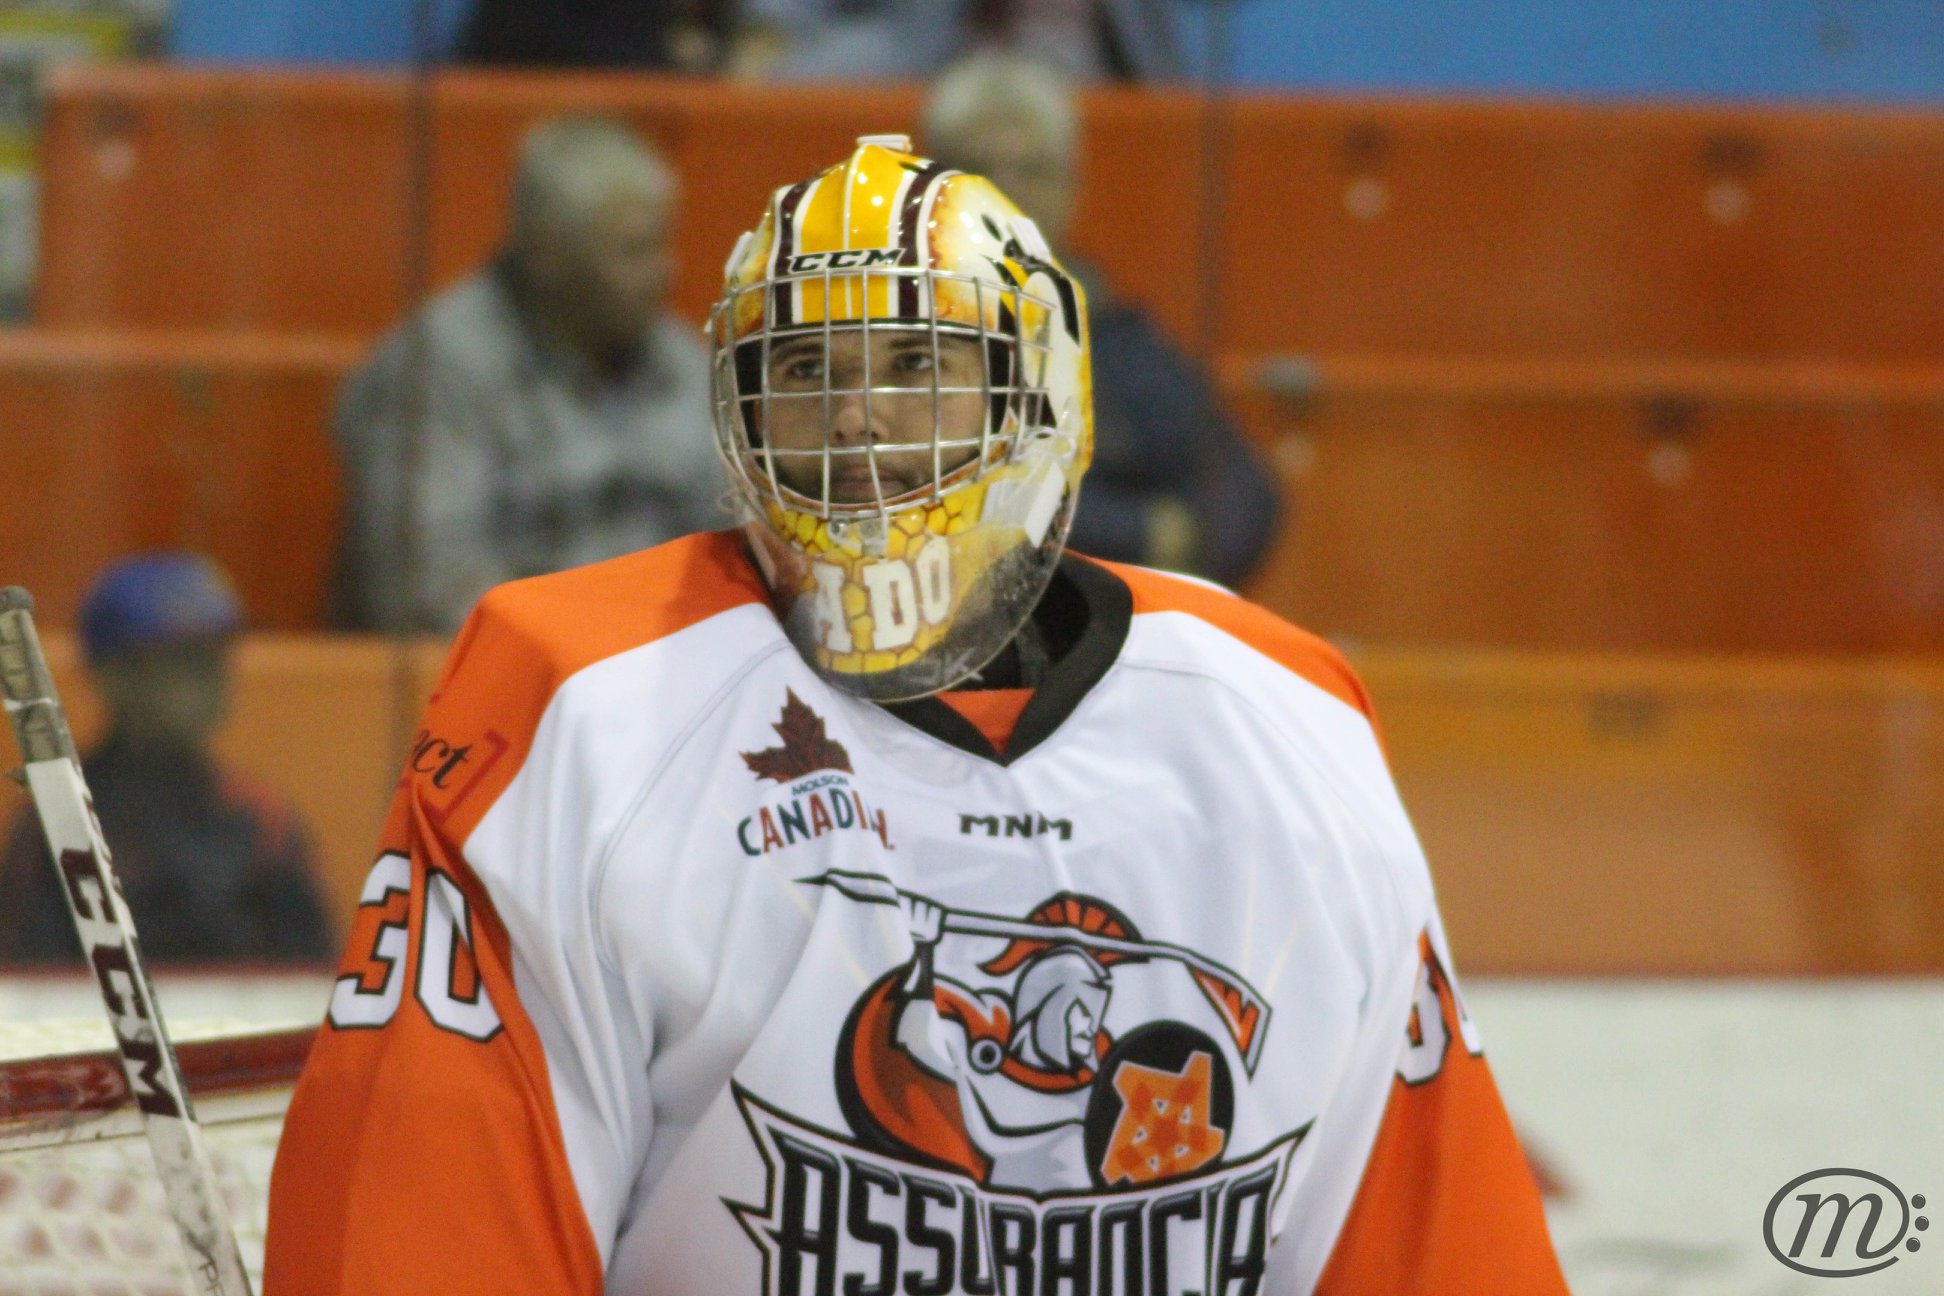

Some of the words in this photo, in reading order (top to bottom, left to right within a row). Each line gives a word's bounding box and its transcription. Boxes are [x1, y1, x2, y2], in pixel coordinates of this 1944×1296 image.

[791, 248, 902, 272] CCM
[958, 811, 1073, 841] MNM
[60, 846, 182, 1118] CCM
[328, 848, 505, 1044] 30
